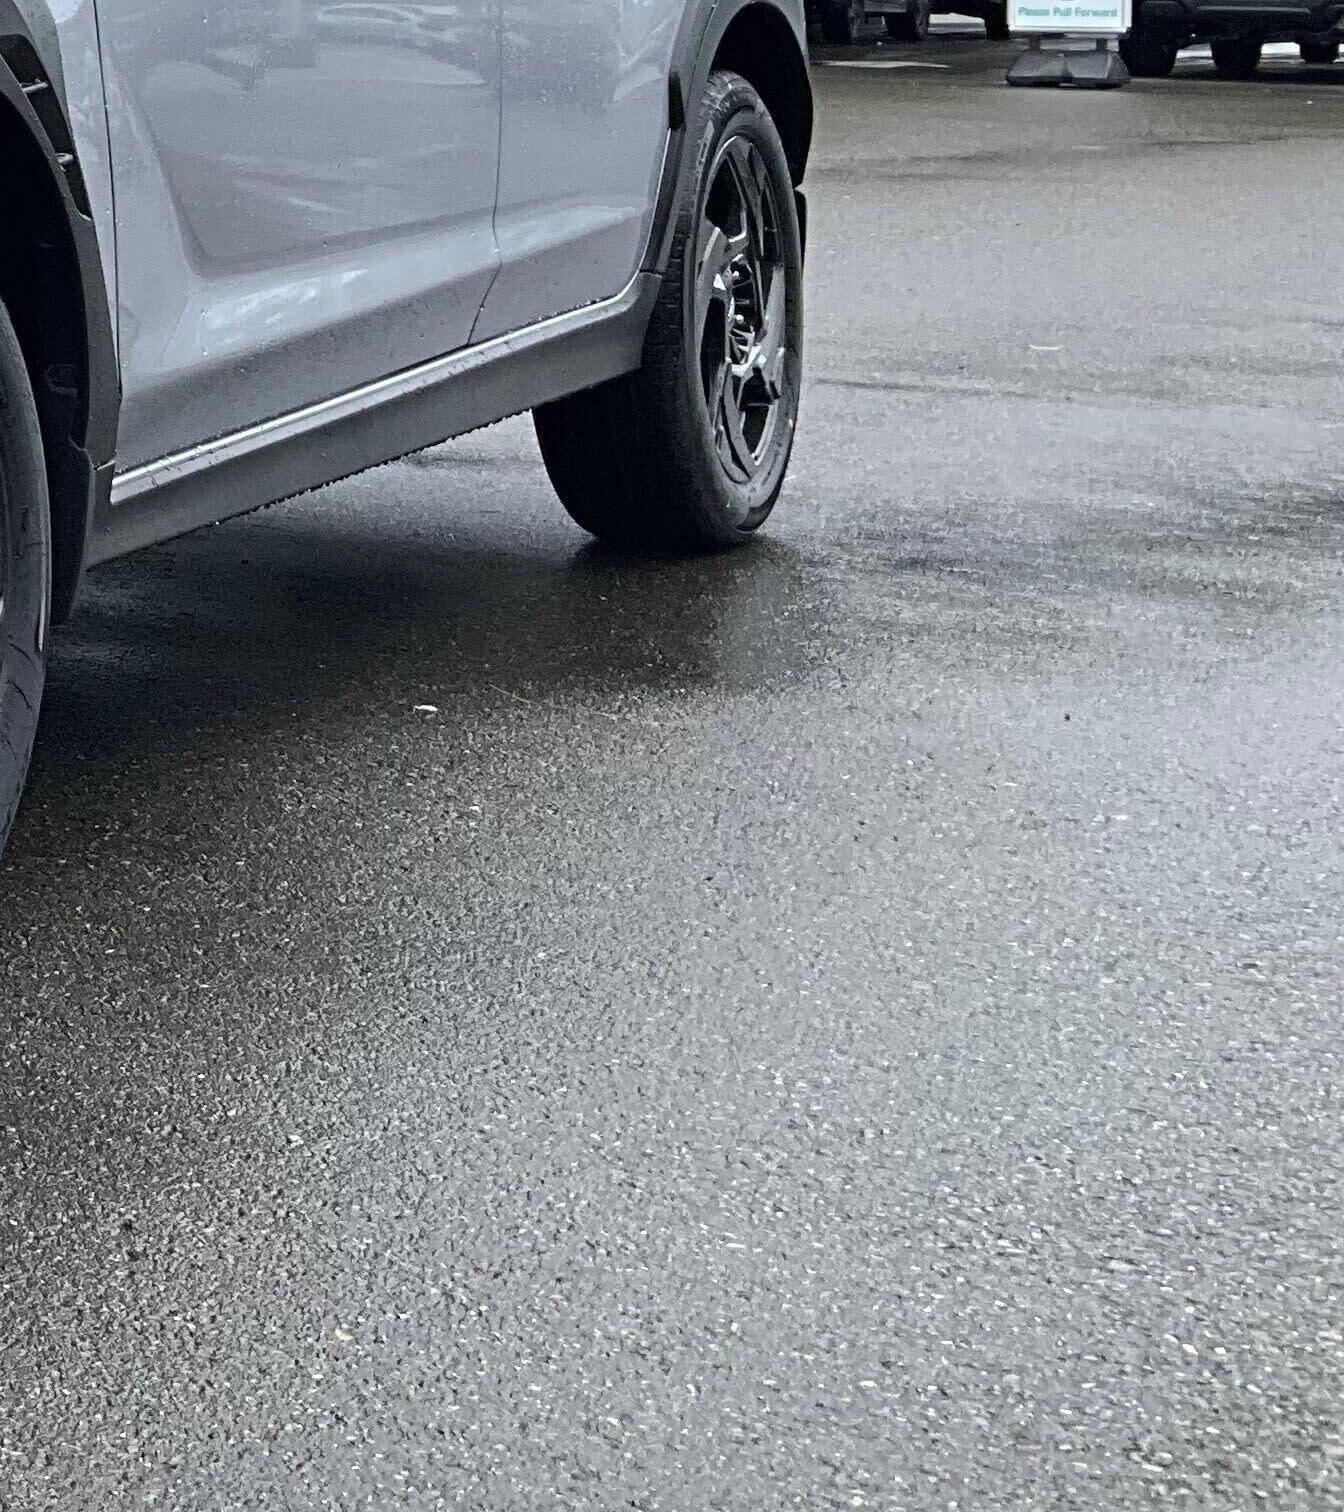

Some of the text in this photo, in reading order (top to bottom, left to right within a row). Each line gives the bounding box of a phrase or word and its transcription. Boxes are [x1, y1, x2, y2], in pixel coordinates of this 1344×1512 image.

[1018, 7, 1117, 17] Please Pull Forward
